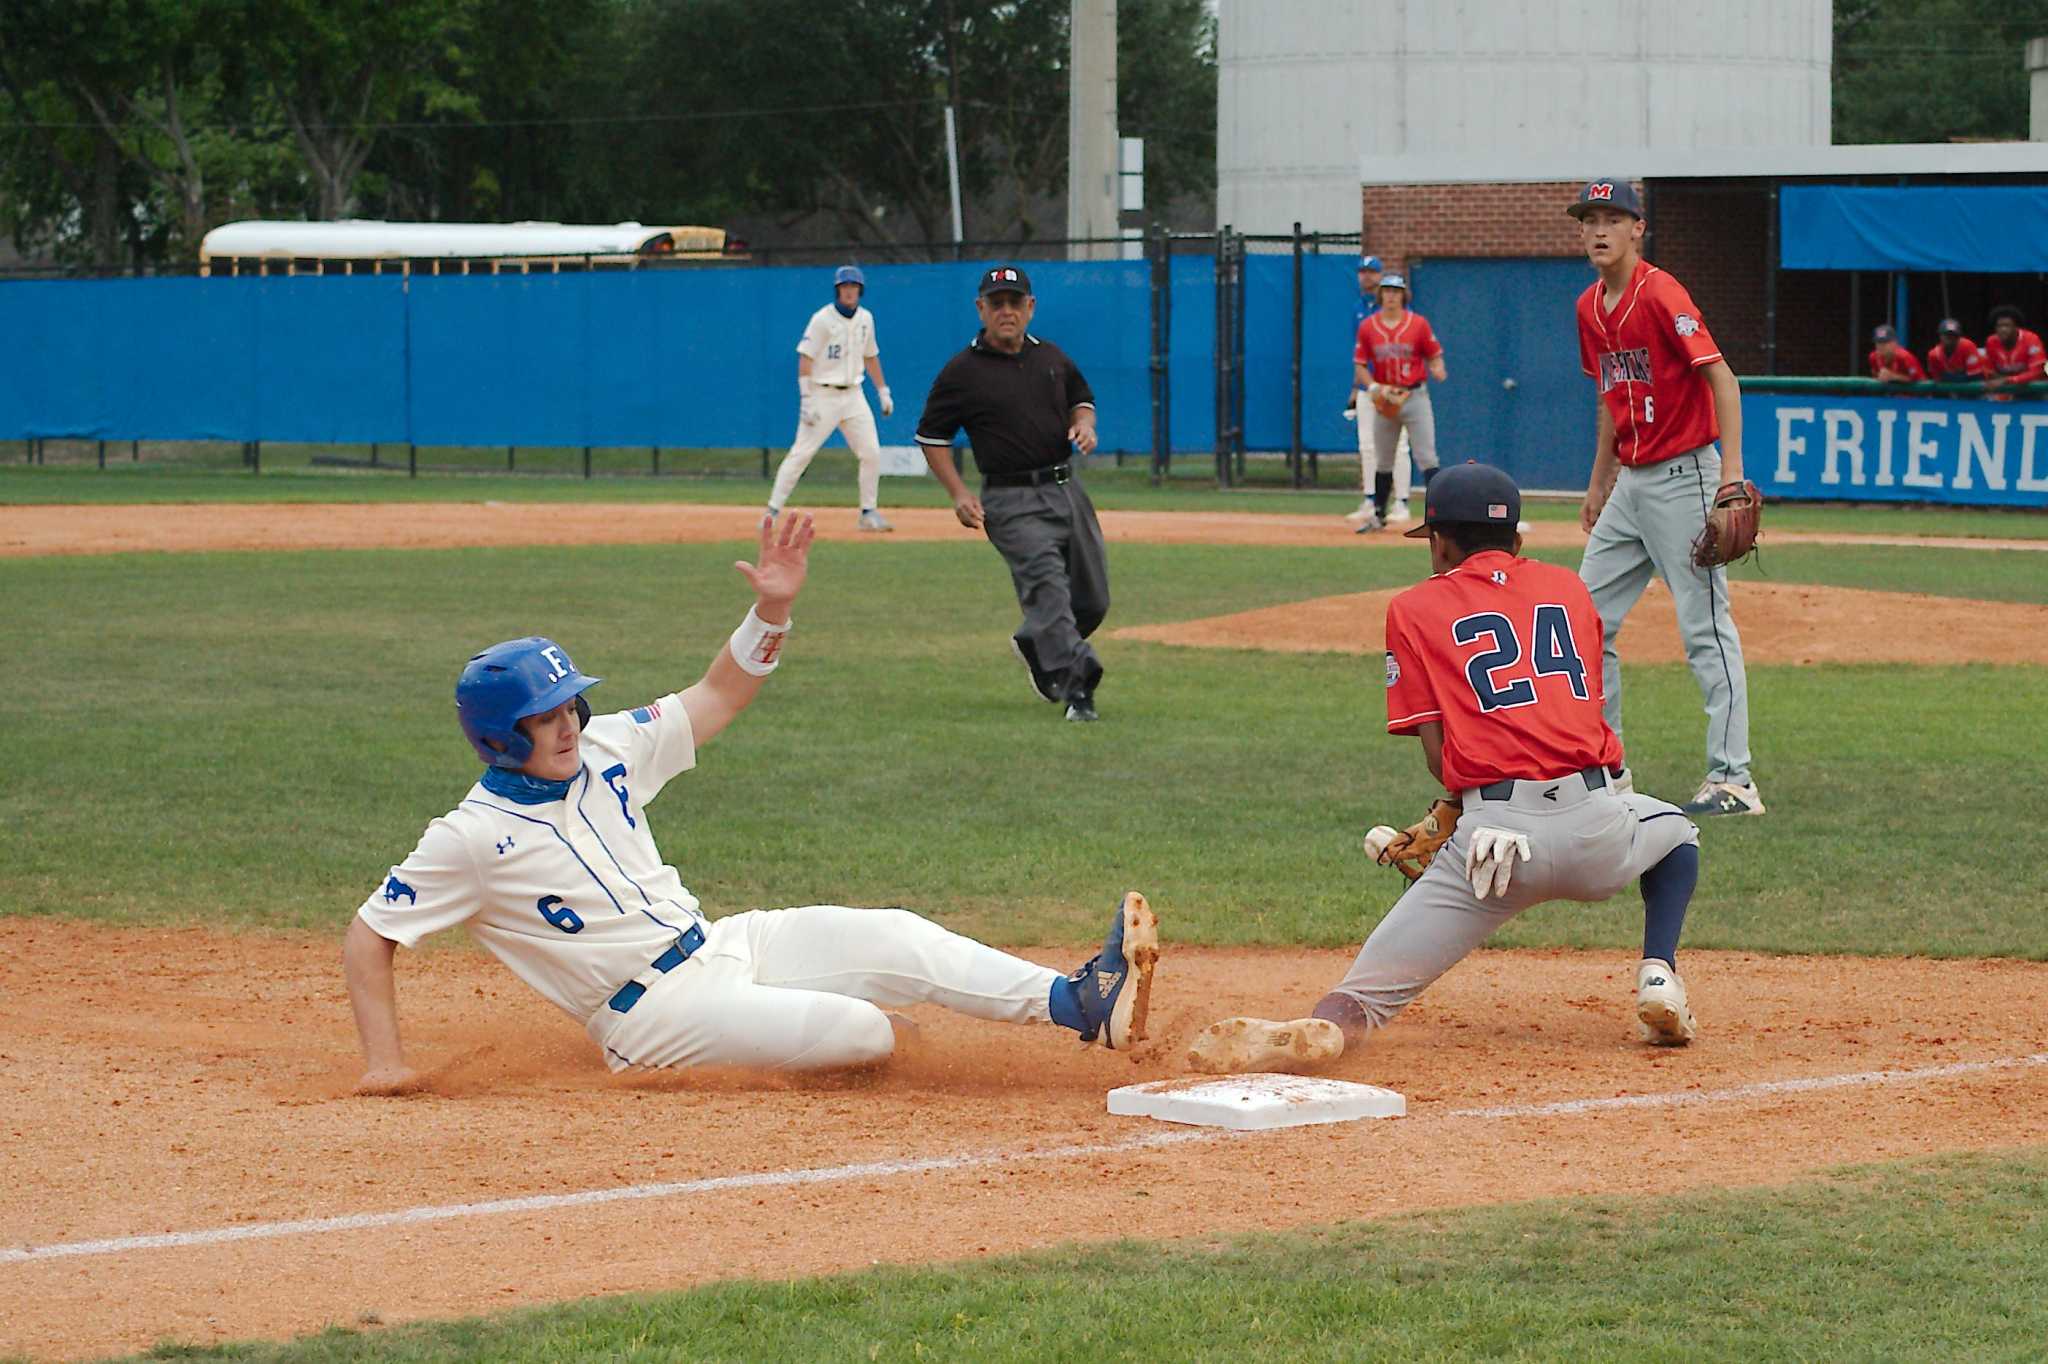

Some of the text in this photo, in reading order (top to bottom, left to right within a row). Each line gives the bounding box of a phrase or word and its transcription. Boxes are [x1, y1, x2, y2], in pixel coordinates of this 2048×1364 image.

[1588, 183, 1614, 200] M
[828, 344, 842, 360] 12
[1644, 395, 1655, 423] 6
[1452, 603, 1589, 713] 24
[600, 763, 636, 830] F
[537, 894, 585, 934] 6
